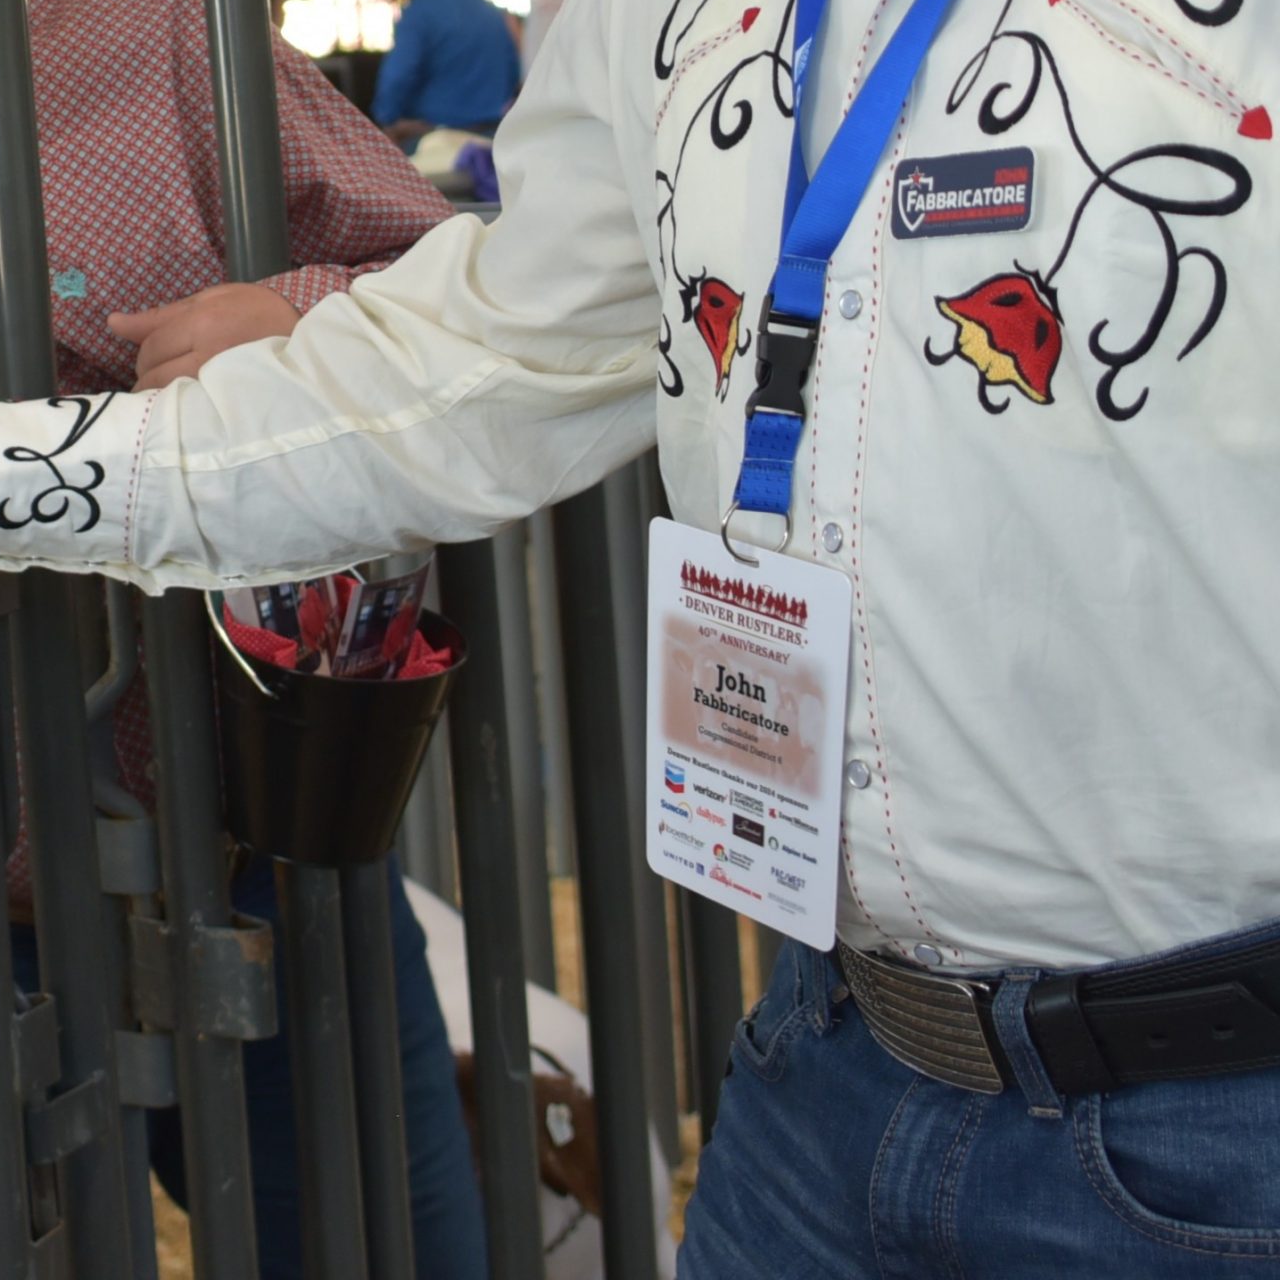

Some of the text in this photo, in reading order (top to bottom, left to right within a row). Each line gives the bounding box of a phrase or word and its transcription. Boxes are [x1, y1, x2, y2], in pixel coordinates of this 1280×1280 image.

[906, 183, 1026, 213] FABBRICATORE
[685, 595, 802, 646] DENVER RUSTLERS
[720, 633, 790, 664] ANNIVERSARY
[715, 664, 767, 703] John
[693, 686, 789, 737] Fabbricatore
[721, 722, 759, 743] Candidate
[693, 783, 726, 803] verizon
[663, 850, 694, 869] UNITED
